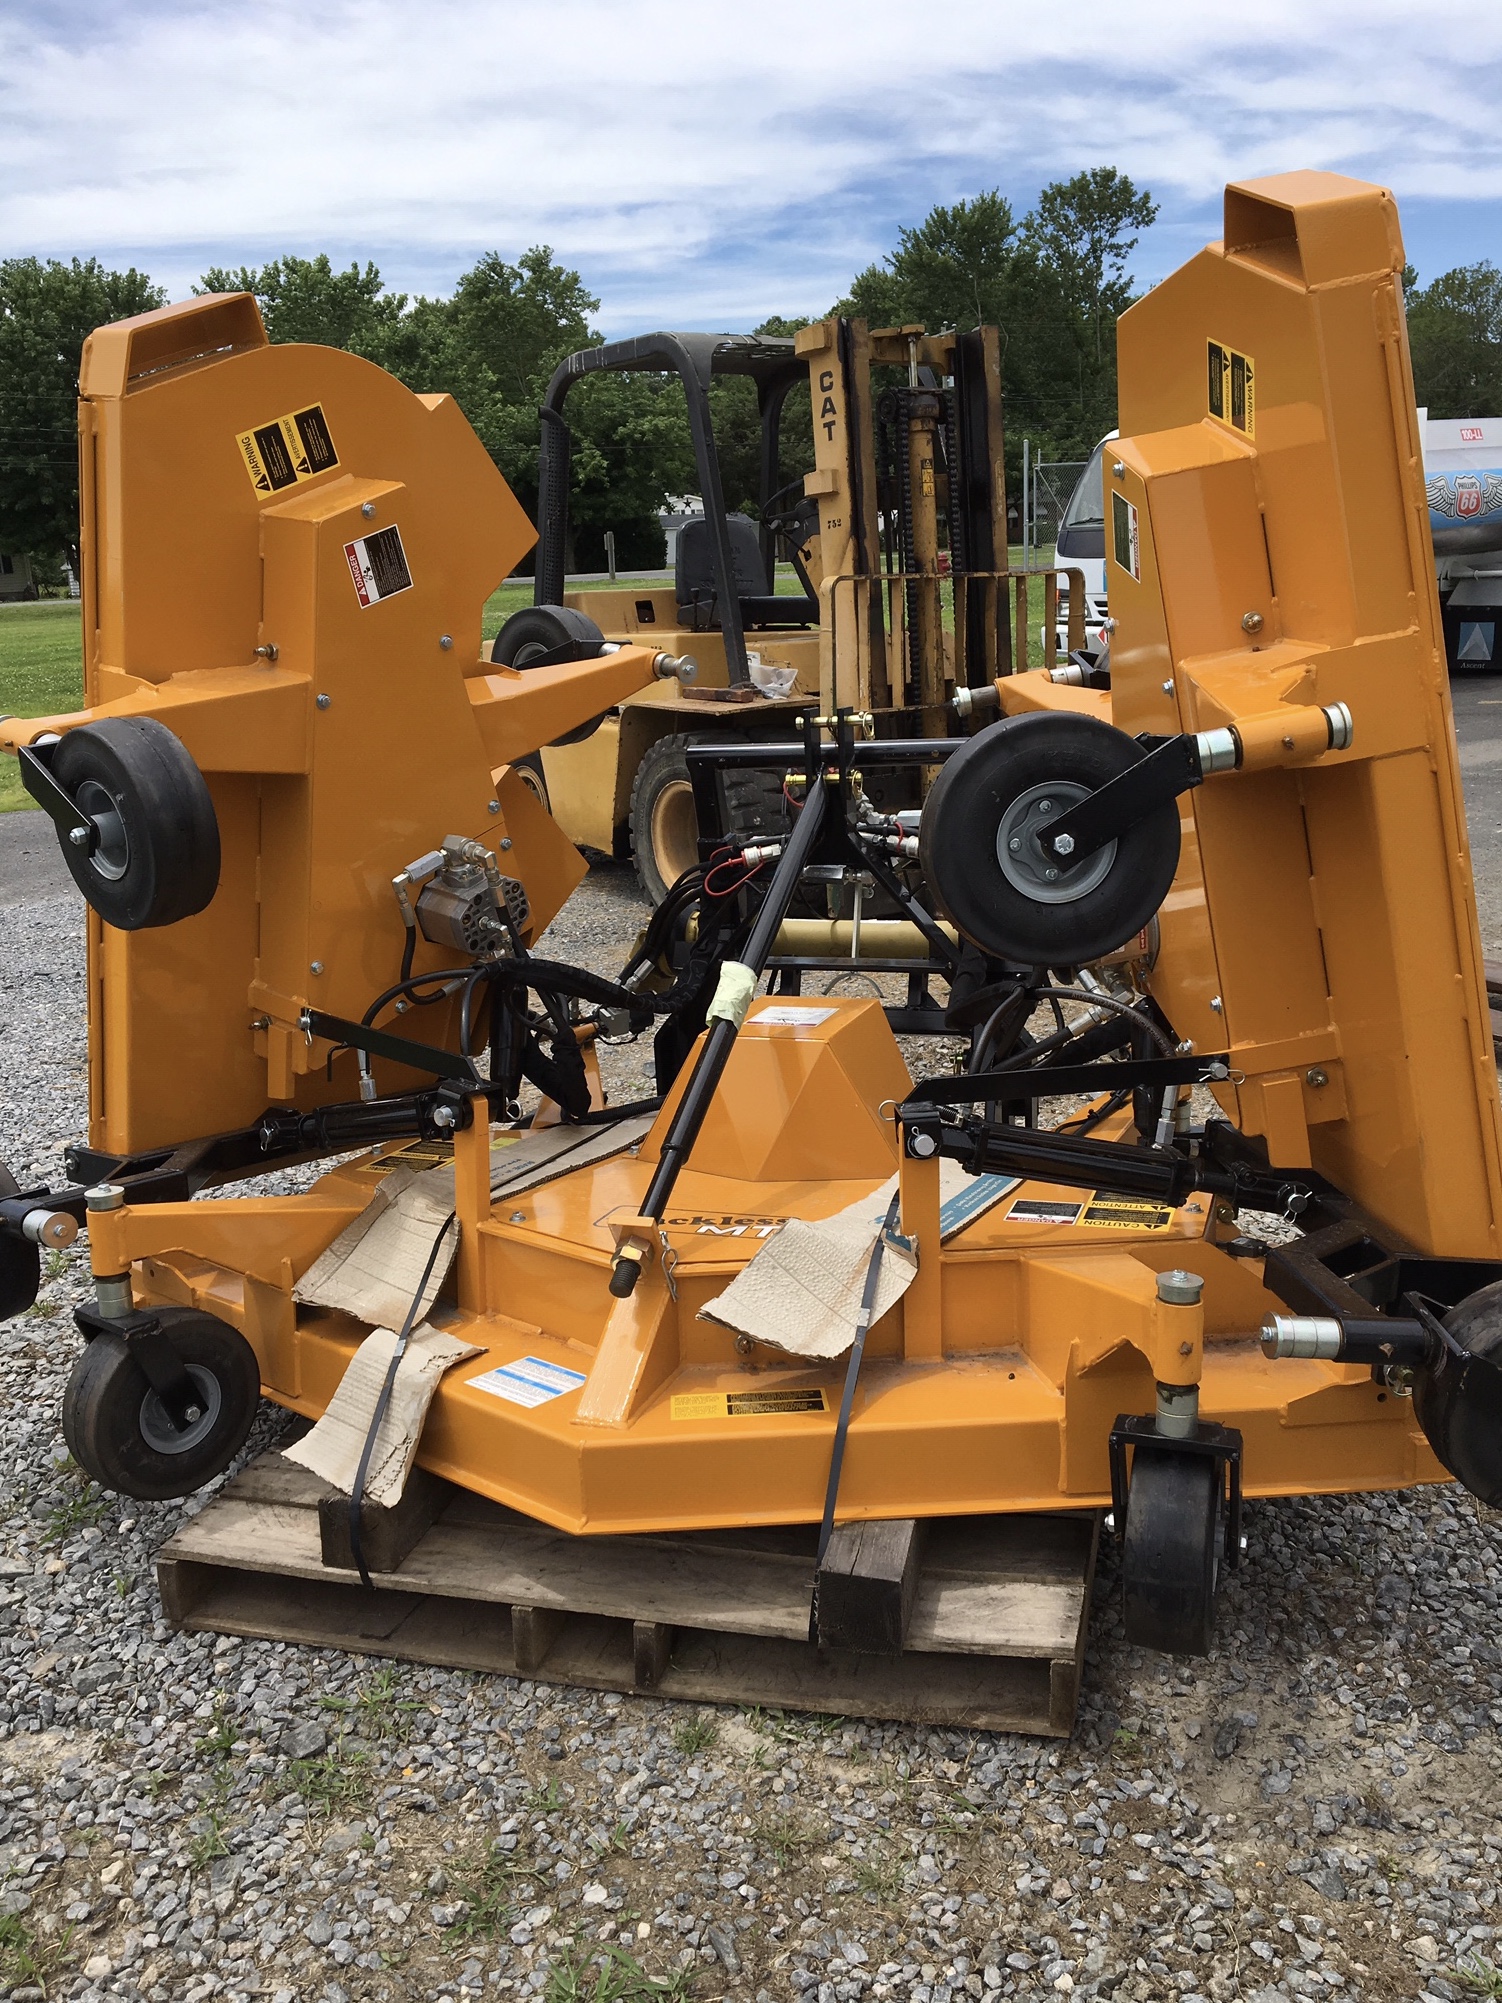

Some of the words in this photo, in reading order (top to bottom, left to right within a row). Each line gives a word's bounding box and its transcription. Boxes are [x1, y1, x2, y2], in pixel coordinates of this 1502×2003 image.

[819, 371, 837, 441] CAT
[283, 419, 302, 460] AVERTISSEMENT
[241, 436, 259, 478] WARNING
[1457, 482, 1479, 490] PHILLIPS
[1460, 493, 1478, 510] 66
[827, 518, 842, 530] 752
[349, 554, 363, 588] DANGER
[1091, 1201, 1146, 1210] ATTENTION
[1084, 1219, 1140, 1229] CAUTION
